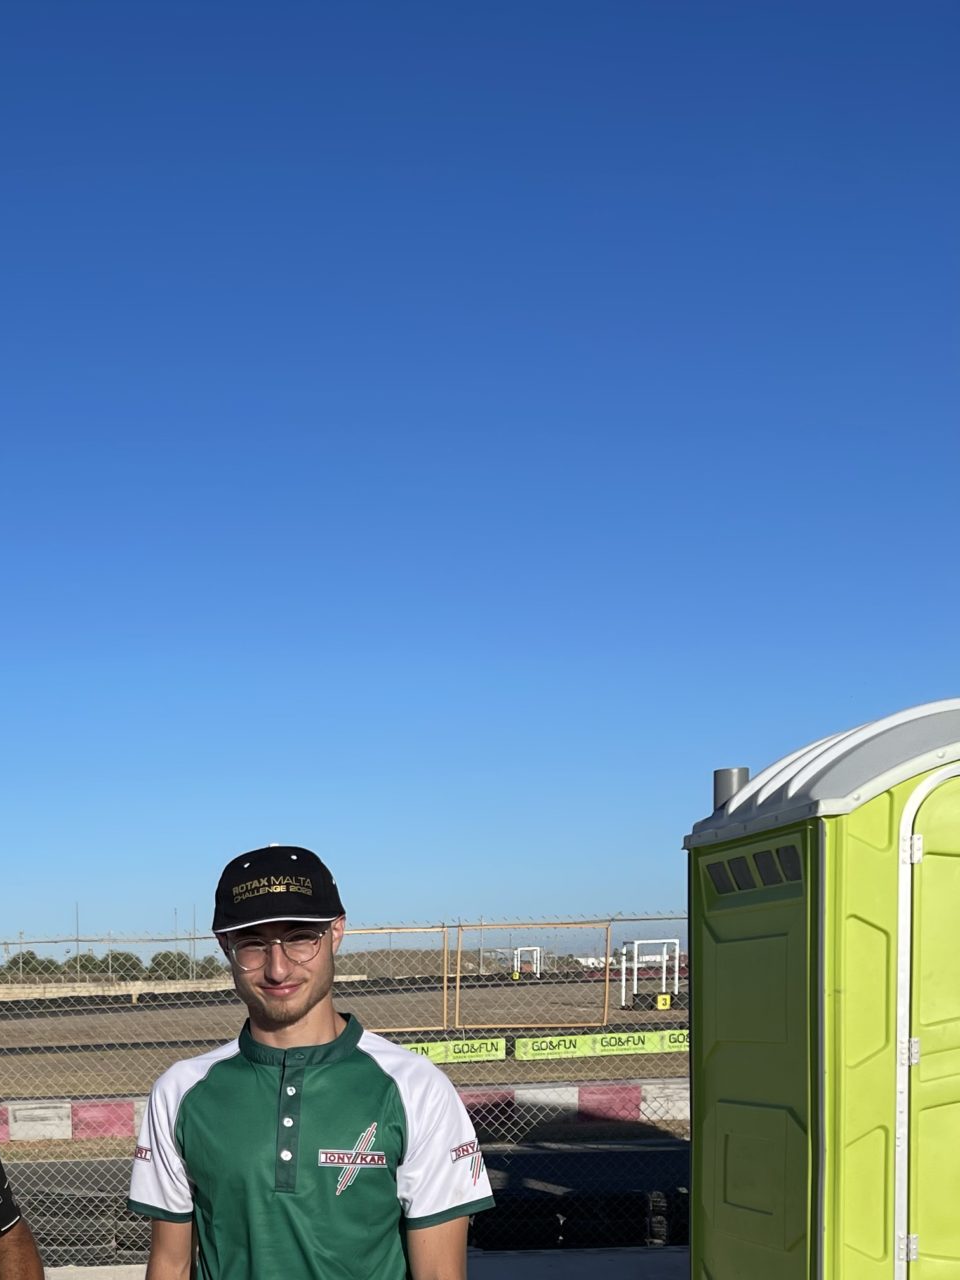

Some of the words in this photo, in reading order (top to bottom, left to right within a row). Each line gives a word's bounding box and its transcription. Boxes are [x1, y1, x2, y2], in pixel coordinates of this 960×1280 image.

[232, 878, 268, 896] ROTAX
[271, 876, 312, 888] MALTA
[234, 885, 287, 904] CHALLENGE
[289, 885, 312, 896] 2022
[531, 1039, 577, 1051] GO&FUN
[600, 1035, 646, 1047] GO&FUN
[453, 1042, 498, 1054] GO&FUN
[324, 1152, 352, 1163] TONY
[360, 1155, 385, 1164] KAR
